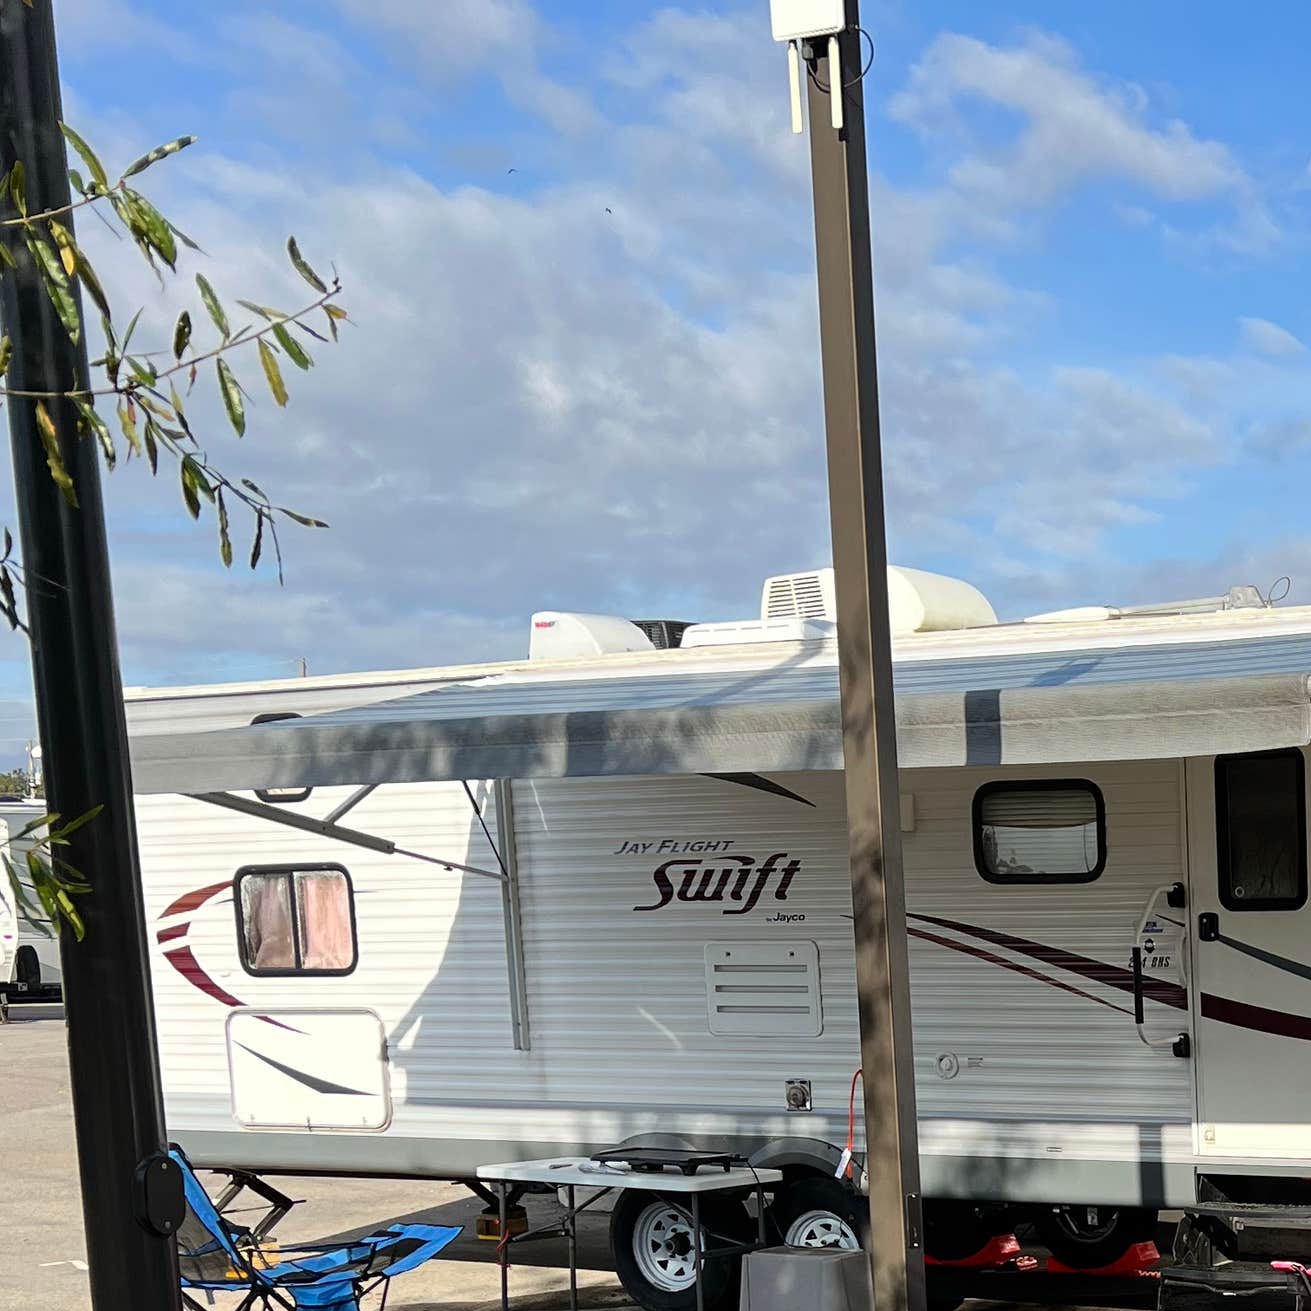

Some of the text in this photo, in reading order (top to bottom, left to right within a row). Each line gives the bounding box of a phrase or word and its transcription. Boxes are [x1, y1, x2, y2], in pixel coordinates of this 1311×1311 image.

[615, 840, 734, 854] JAY FLIGHT
[633, 852, 801, 915] Swift
[773, 911, 806, 923] Jayco
